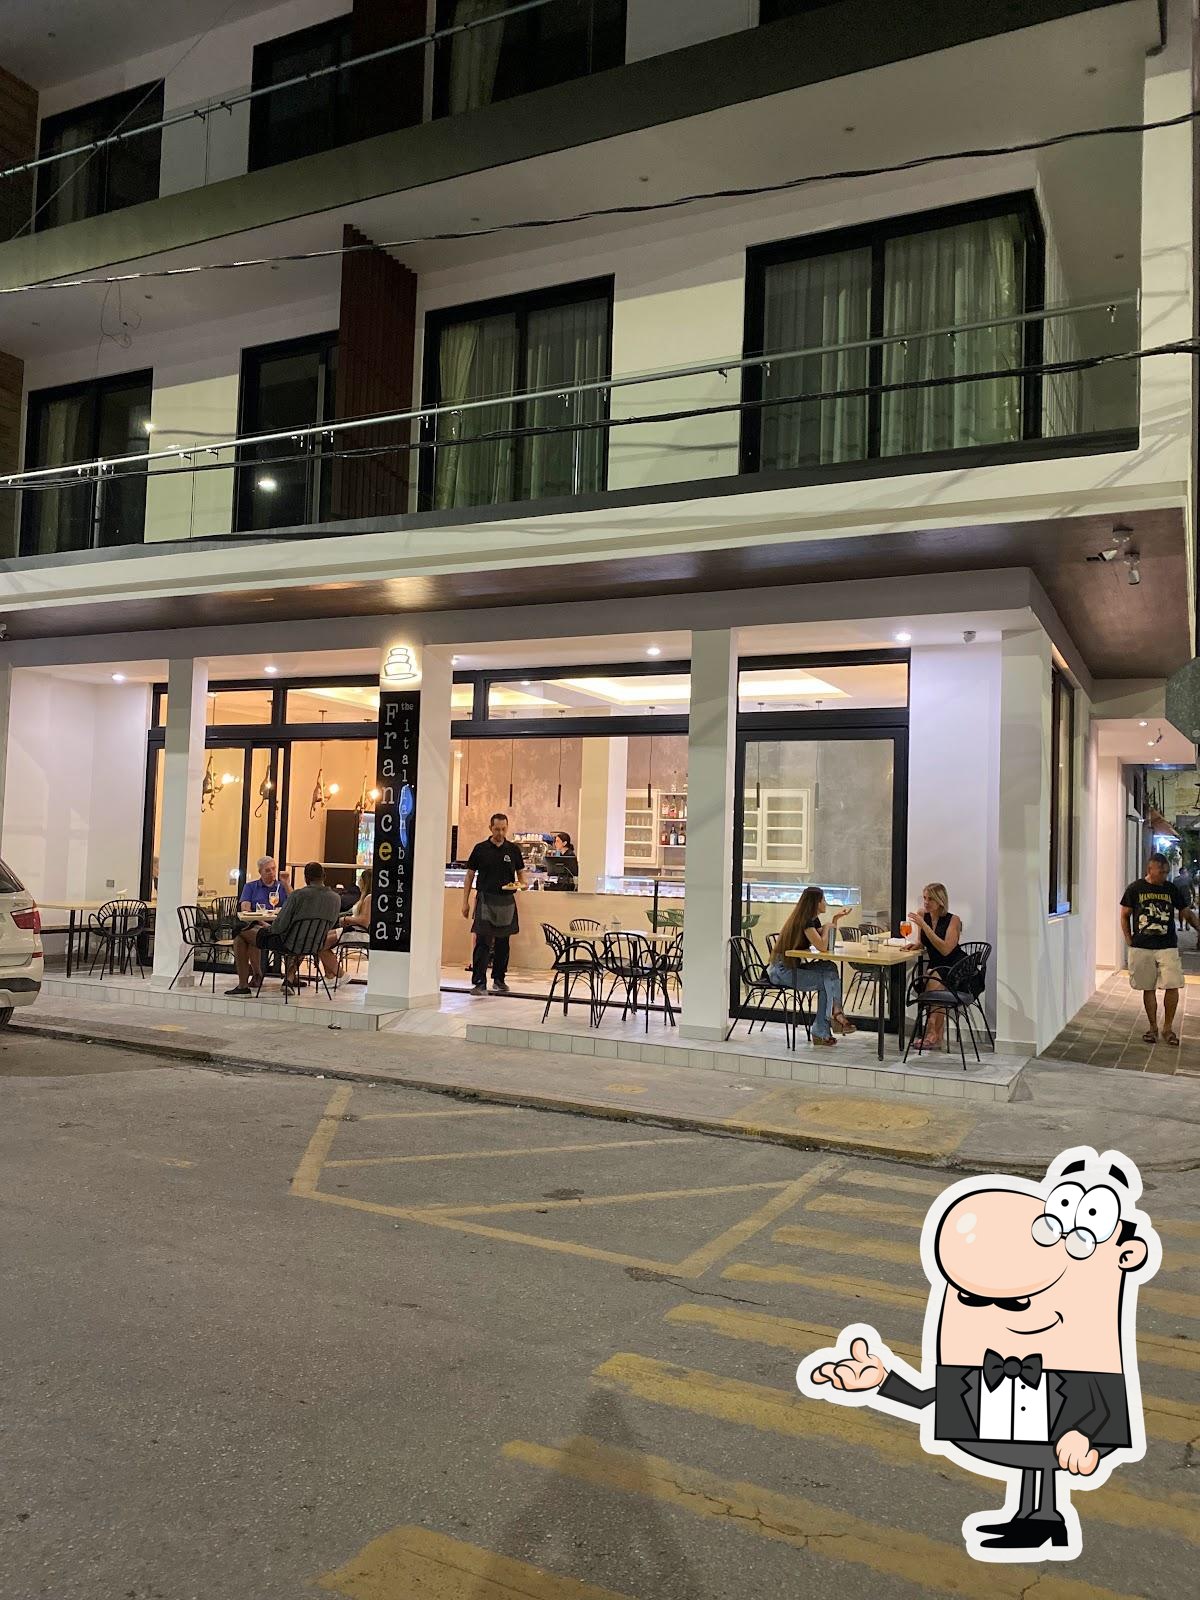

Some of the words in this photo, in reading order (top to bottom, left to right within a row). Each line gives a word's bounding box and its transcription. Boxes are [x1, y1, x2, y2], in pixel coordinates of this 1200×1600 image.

[401, 702, 413, 711] the
[375, 703, 398, 940] Francesca
[395, 847, 405, 940] bakery
